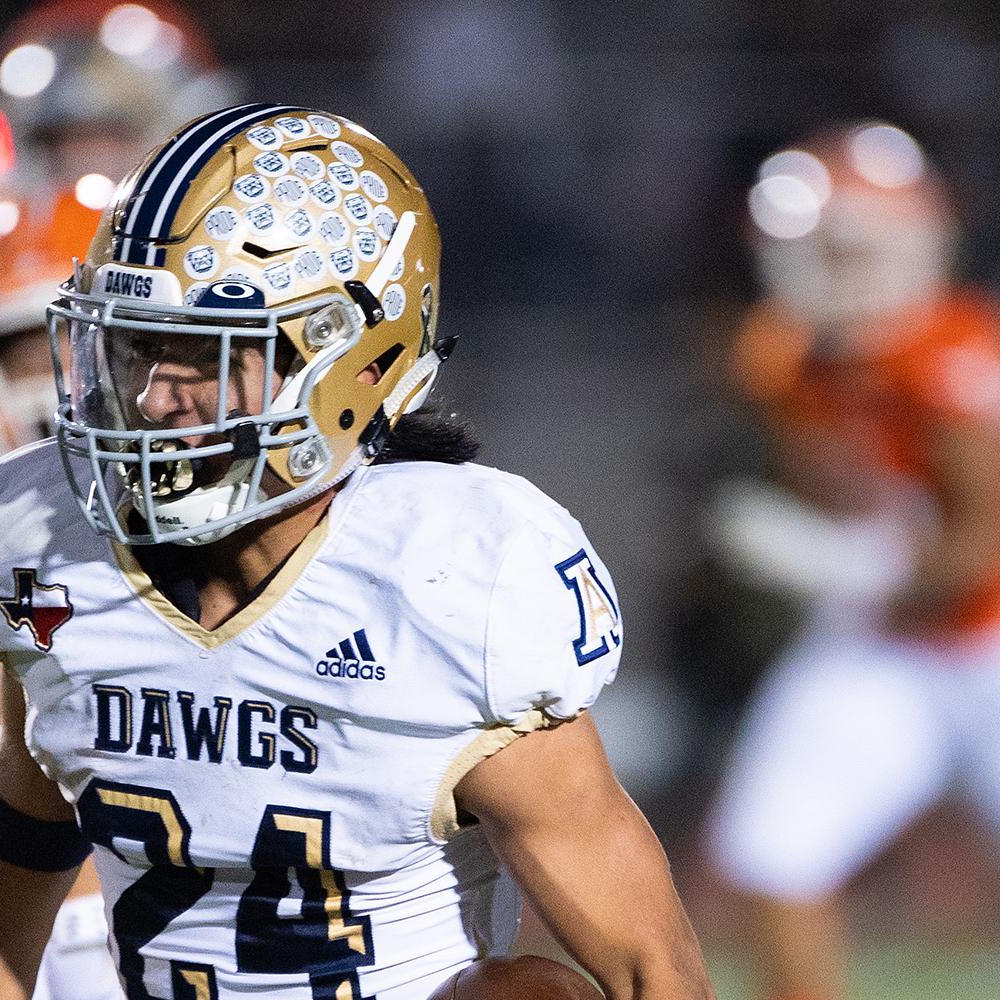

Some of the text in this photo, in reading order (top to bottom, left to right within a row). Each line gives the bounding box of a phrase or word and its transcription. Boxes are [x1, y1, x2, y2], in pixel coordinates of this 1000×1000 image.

[105, 270, 153, 299] DAWGS
[554, 548, 621, 667] A
[316, 657, 386, 681] adidas
[92, 684, 318, 774] DAWGS
